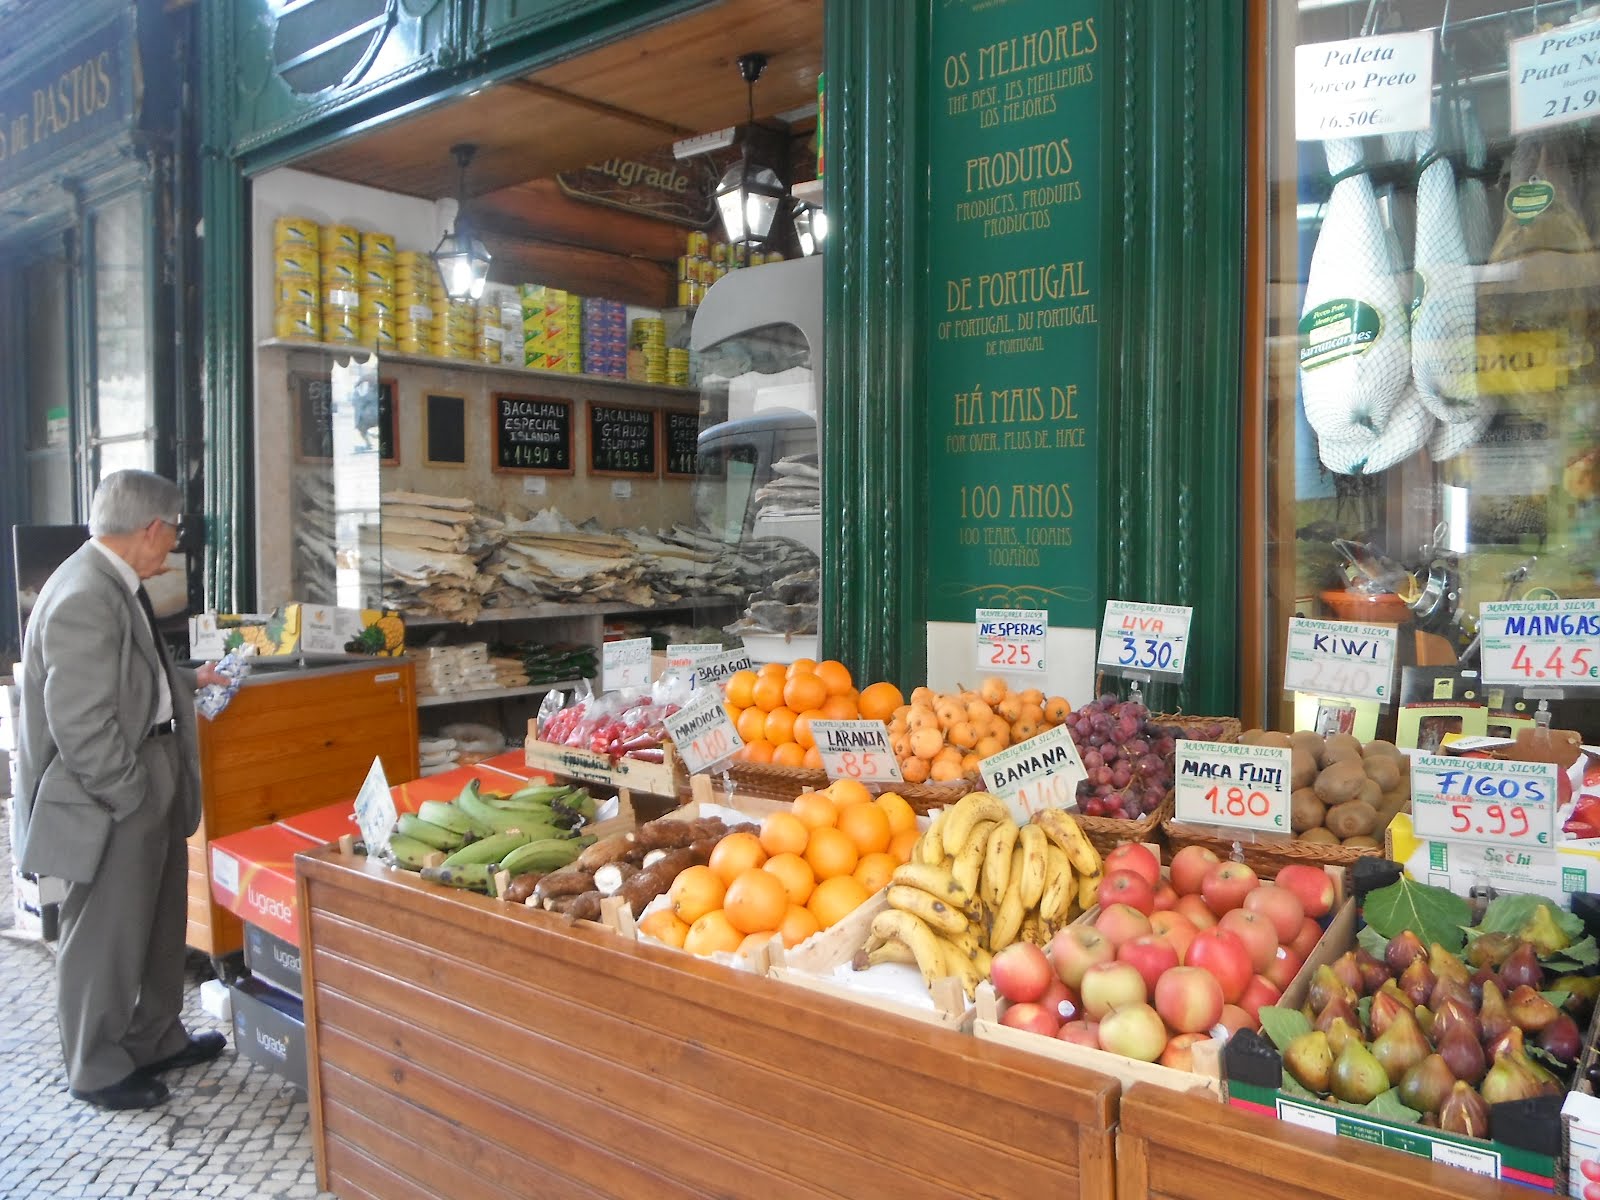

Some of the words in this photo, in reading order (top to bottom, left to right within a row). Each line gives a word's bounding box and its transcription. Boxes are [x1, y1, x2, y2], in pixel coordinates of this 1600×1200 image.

[944, 52, 970, 89] OS
[978, 17, 1099, 81] MELHORES
[1324, 46, 1394, 67] Paleta
[1363, 72, 1416, 88] Preto
[1520, 63, 1570, 84] Pata
[33, 51, 110, 144] PASTOS
[947, 93, 968, 115] THE
[1006, 80, 1024, 102] LES
[1026, 63, 1094, 96] MEILLEURS
[980, 108, 999, 129] LOS
[1003, 93, 1057, 123] MEJORES
[1543, 89, 1600, 118] 21.9
[586, 157, 689, 193] ugrade
[966, 138, 1073, 193] PRODUTOS
[1023, 181, 1082, 209] PRODUITS
[984, 209, 1051, 238] PRODUCTOS
[946, 278, 972, 312] DE
[978, 261, 1090, 309] PORTUGAL
[938, 322, 952, 340] OF
[1018, 312, 1034, 331] DU
[1037, 304, 1098, 329] PORTUGAL
[986, 341, 997, 356] DE
[999, 336, 1045, 355] PORTUGAL
[502, 400, 564, 417] BACALHAU
[594, 407, 649, 423] BACALHAU
[954, 384, 985, 425] HÁ
[990, 387, 1045, 424] MAIS
[1050, 384, 1079, 420] DE
[505, 417, 560, 430] ESPECIAL
[510, 431, 560, 442] ISLANDIA
[946, 434, 966, 453] FOR
[1004, 431, 1031, 450] PLUS
[1055, 428, 1086, 448] HACE
[961, 485, 1000, 519] 100
[1009, 483, 1074, 518] ANOS
[959, 527, 980, 545] 100
[1488, 602, 1559, 613] MANTEIGARIA
[1563, 601, 1595, 610] SILVA
[980, 622, 1043, 637] NESPERAS
[1122, 615, 1164, 633] UVA
[1295, 619, 1359, 633] MANTEIGARIA
[1362, 627, 1390, 637] SILVA
[1505, 614, 1600, 636] MANGAS
[991, 643, 1030, 665] 2.25
[1119, 637, 1172, 668] 3.30
[1511, 644, 1592, 678] 4.45
[1589, 666, 1598, 678] €
[1375, 685, 1384, 696] €
[675, 705, 725, 740] MANDIOCA
[827, 730, 886, 747] LARANJA
[1184, 742, 1250, 755] MANTEIGARIA
[1254, 748, 1283, 758] SILVA
[993, 746, 1067, 788] BANANA
[1239, 762, 1282, 785] FUJI
[1418, 756, 1504, 772] MANTEIGARIA
[1509, 763, 1547, 775] SILVA
[1436, 770, 1545, 802] FIGOS
[1205, 785, 1270, 817] 1.80
[1274, 814, 1283, 826] €
[1451, 804, 1529, 837] 5.99
[1537, 831, 1548, 844] €
[247, 882, 292, 925] lugrade
[256, 1027, 287, 1057] lugrade
